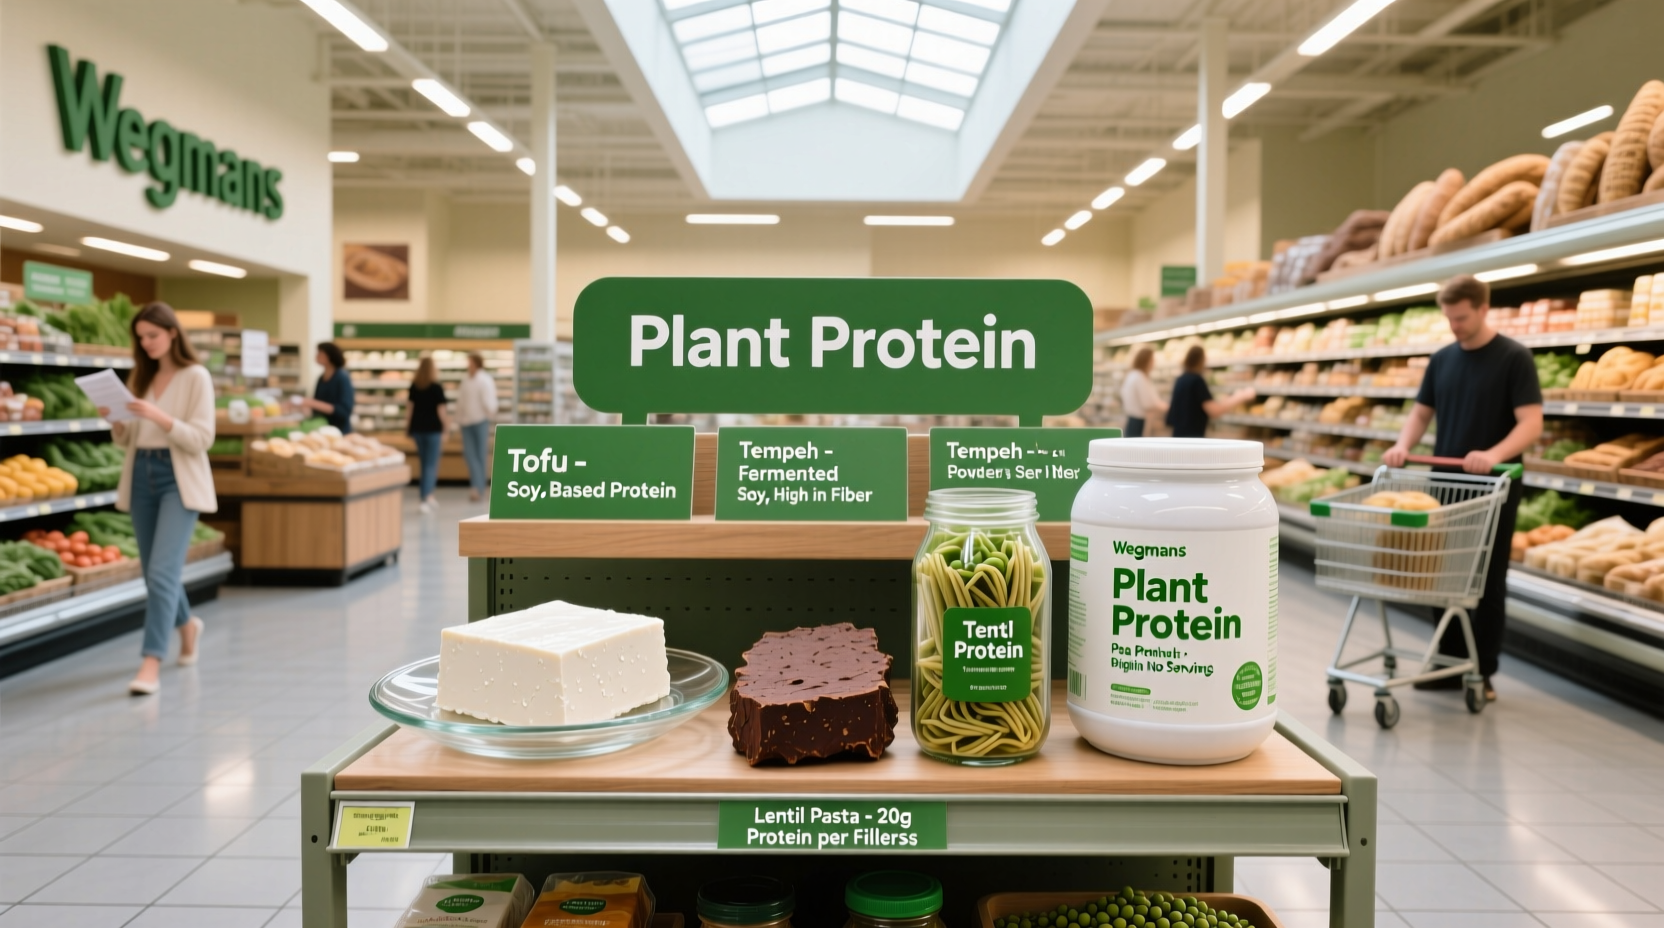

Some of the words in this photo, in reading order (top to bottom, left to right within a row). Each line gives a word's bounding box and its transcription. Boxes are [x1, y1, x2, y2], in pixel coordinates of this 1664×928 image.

[46, 43, 284, 221] Wegmans
[630, 314, 790, 368] Plant
[811, 313, 1036, 370] Protein
[507, 447, 568, 473] Tofu
[738, 440, 819, 464] Tempeh
[946, 441, 1023, 464] Tempeh
[738, 464, 839, 482] Fermented
[549, 480, 606, 499] Based
[610, 481, 677, 499] Protein
[737, 486, 770, 506] Soy,
[773, 486, 809, 506] High
[812, 486, 827, 502] in
[831, 486, 874, 503] Fiber
[1112, 540, 1187, 561] Wegmans
[1113, 567, 1209, 604] Plant
[962, 619, 1014, 639] Tentl
[1112, 604, 1242, 641] Protein
[954, 640, 1024, 660] Protein
[754, 806, 805, 824] Lentil
[810, 807, 860, 824] Pasta
[877, 807, 912, 829] 20g
[747, 828, 812, 845] Protein
[817, 832, 849, 850] per
[853, 827, 918, 846] Fillerss
